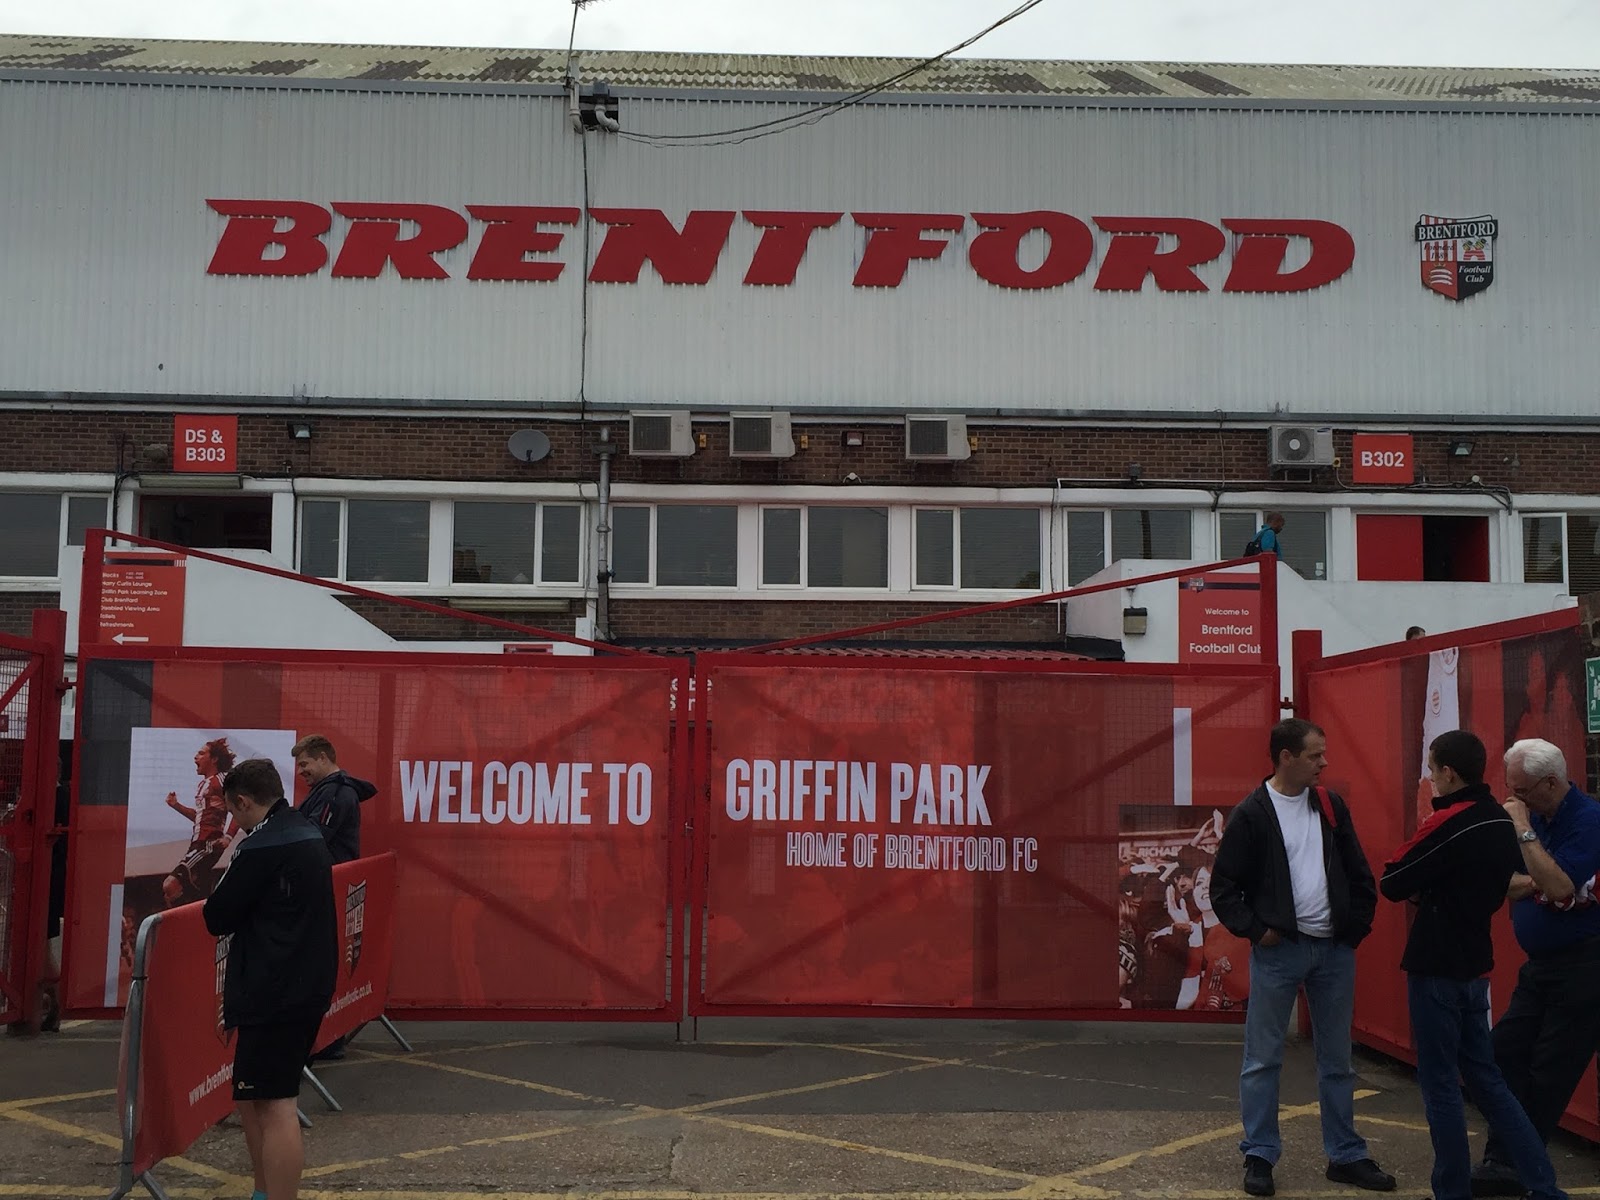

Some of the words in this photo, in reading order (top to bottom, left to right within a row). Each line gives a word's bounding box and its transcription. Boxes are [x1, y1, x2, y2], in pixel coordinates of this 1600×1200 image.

[1418, 222, 1496, 240] BRENTFORD
[205, 199, 1356, 293] BRENTFORD
[1458, 265, 1491, 274] Football
[1465, 275, 1484, 283] Club
[185, 429, 207, 444] DS
[210, 429, 223, 444] &
[185, 447, 226, 462] B303
[1361, 450, 1405, 468] B302
[124, 605, 146, 613] Viewing
[1201, 624, 1253, 635] Brentford
[1189, 643, 1235, 654] Football
[400, 760, 592, 825] WELCOME
[603, 762, 652, 826] TO
[725, 758, 876, 823] GRIFFIN
[890, 762, 992, 826] PARK
[786, 831, 847, 867] HOME
[853, 833, 879, 868] OF
[884, 834, 1006, 872] BRENTFORD
[1012, 837, 1038, 872] FC
